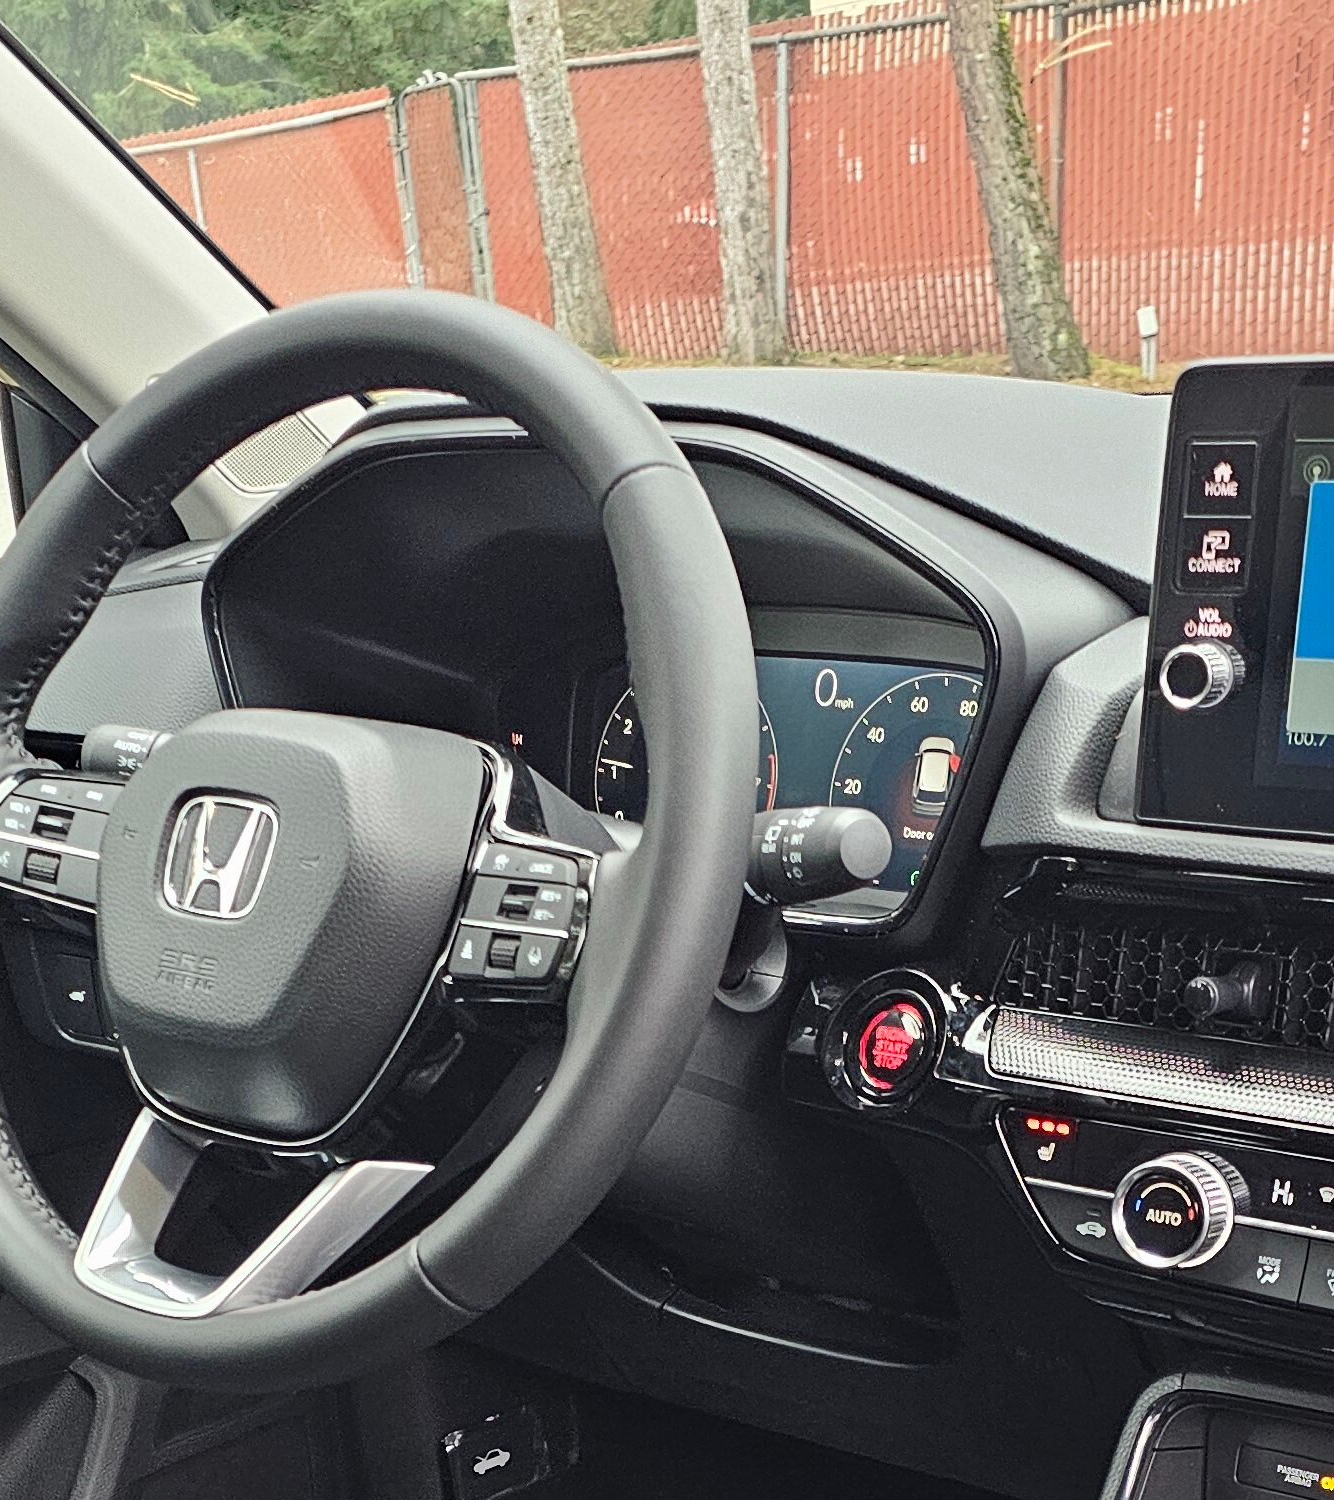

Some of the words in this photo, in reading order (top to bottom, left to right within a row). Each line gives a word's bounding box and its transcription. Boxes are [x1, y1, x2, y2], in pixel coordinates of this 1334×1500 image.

[1204, 481, 1239, 498] HOME
[1187, 557, 1242, 574] CONNECT
[1198, 607, 1222, 623] VOL
[1196, 622, 1233, 639] AUDIO
[814, 667, 838, 708] 0
[835, 697, 854, 710] mph
[910, 696, 929, 714] 60
[959, 700, 979, 717] 80
[622, 718, 634, 735] 2
[866, 727, 885, 744] 40
[843, 778, 862, 796] 20
[874, 1039, 910, 1055] START
[873, 1055, 905, 1070] STOP
[1145, 1208, 1183, 1227] AUTO
[1258, 1255, 1282, 1268] MODE
